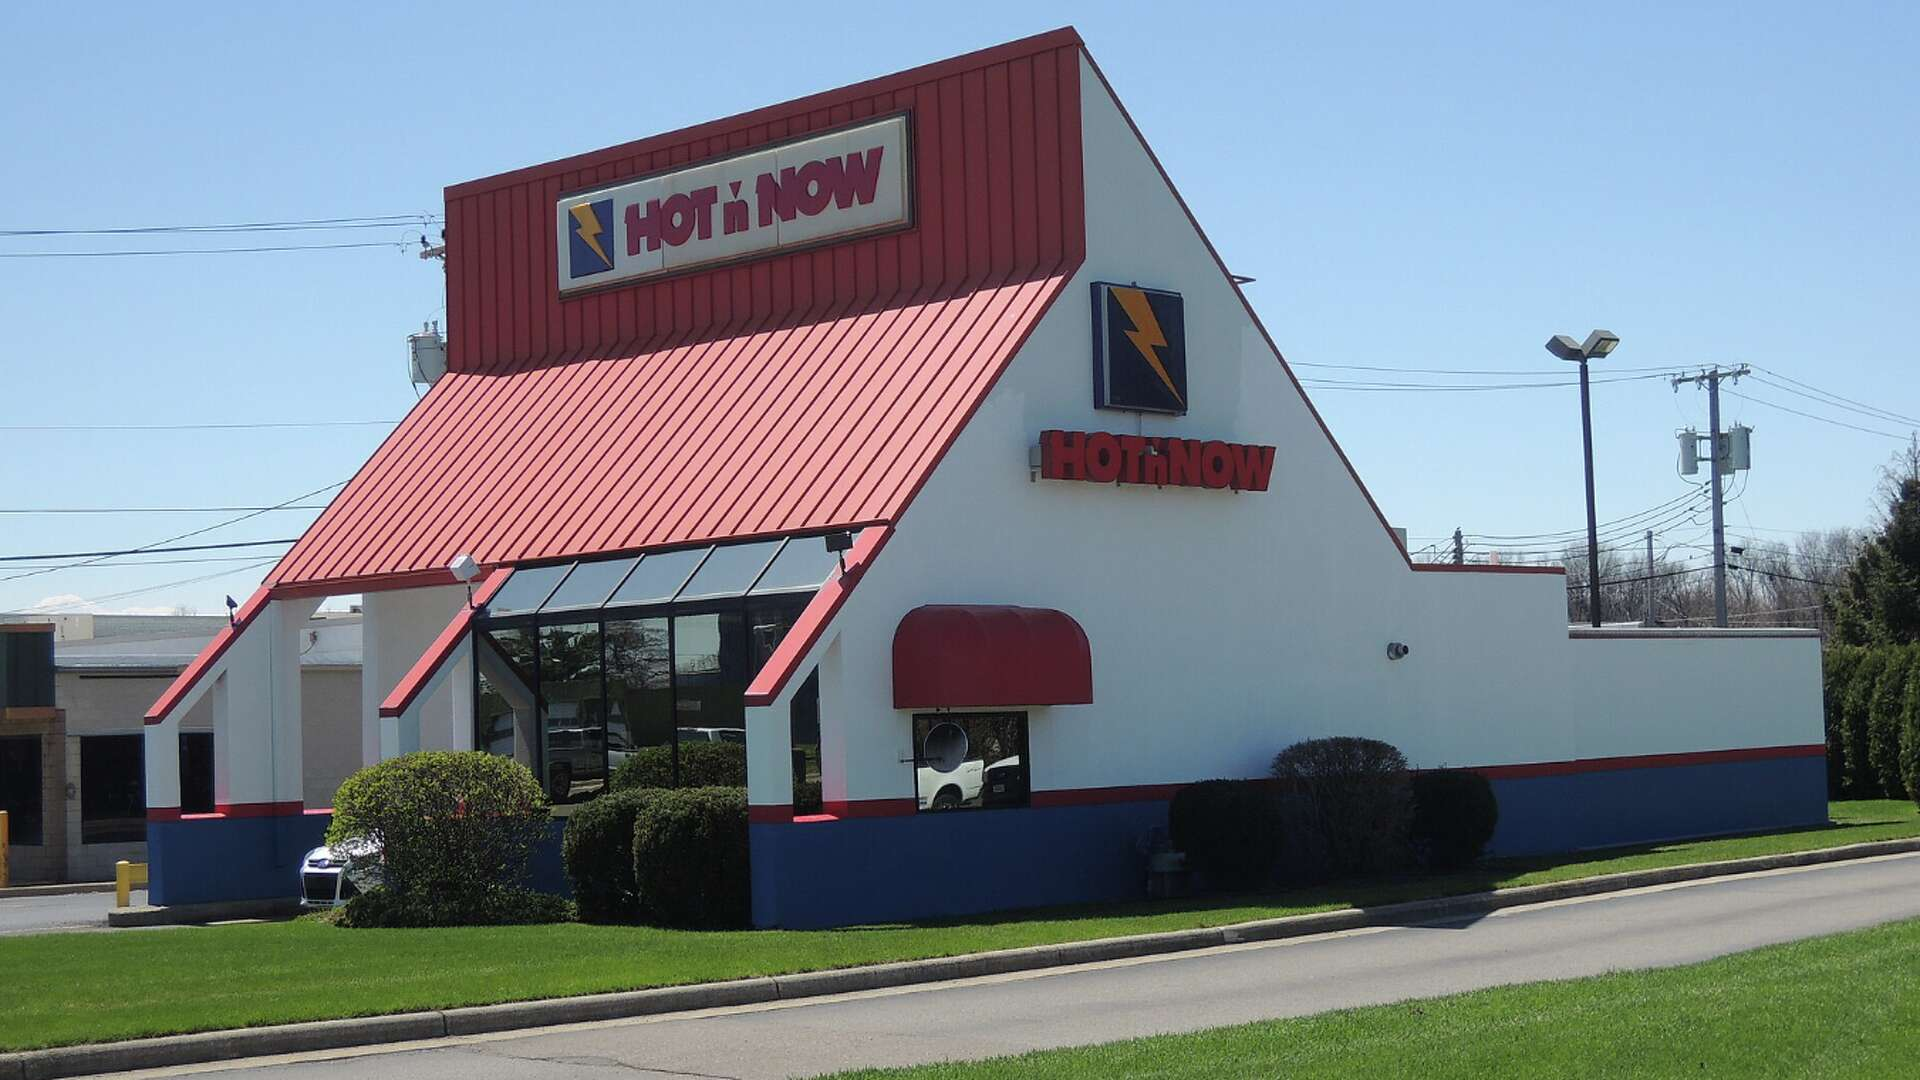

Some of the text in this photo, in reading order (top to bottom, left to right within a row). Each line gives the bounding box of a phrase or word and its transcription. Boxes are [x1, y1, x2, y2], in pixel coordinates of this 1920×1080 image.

[624, 186, 717, 256] HOT
[755, 146, 884, 227] NOW
[1043, 430, 1144, 483] HOT
[1168, 438, 1277, 491] NOW
